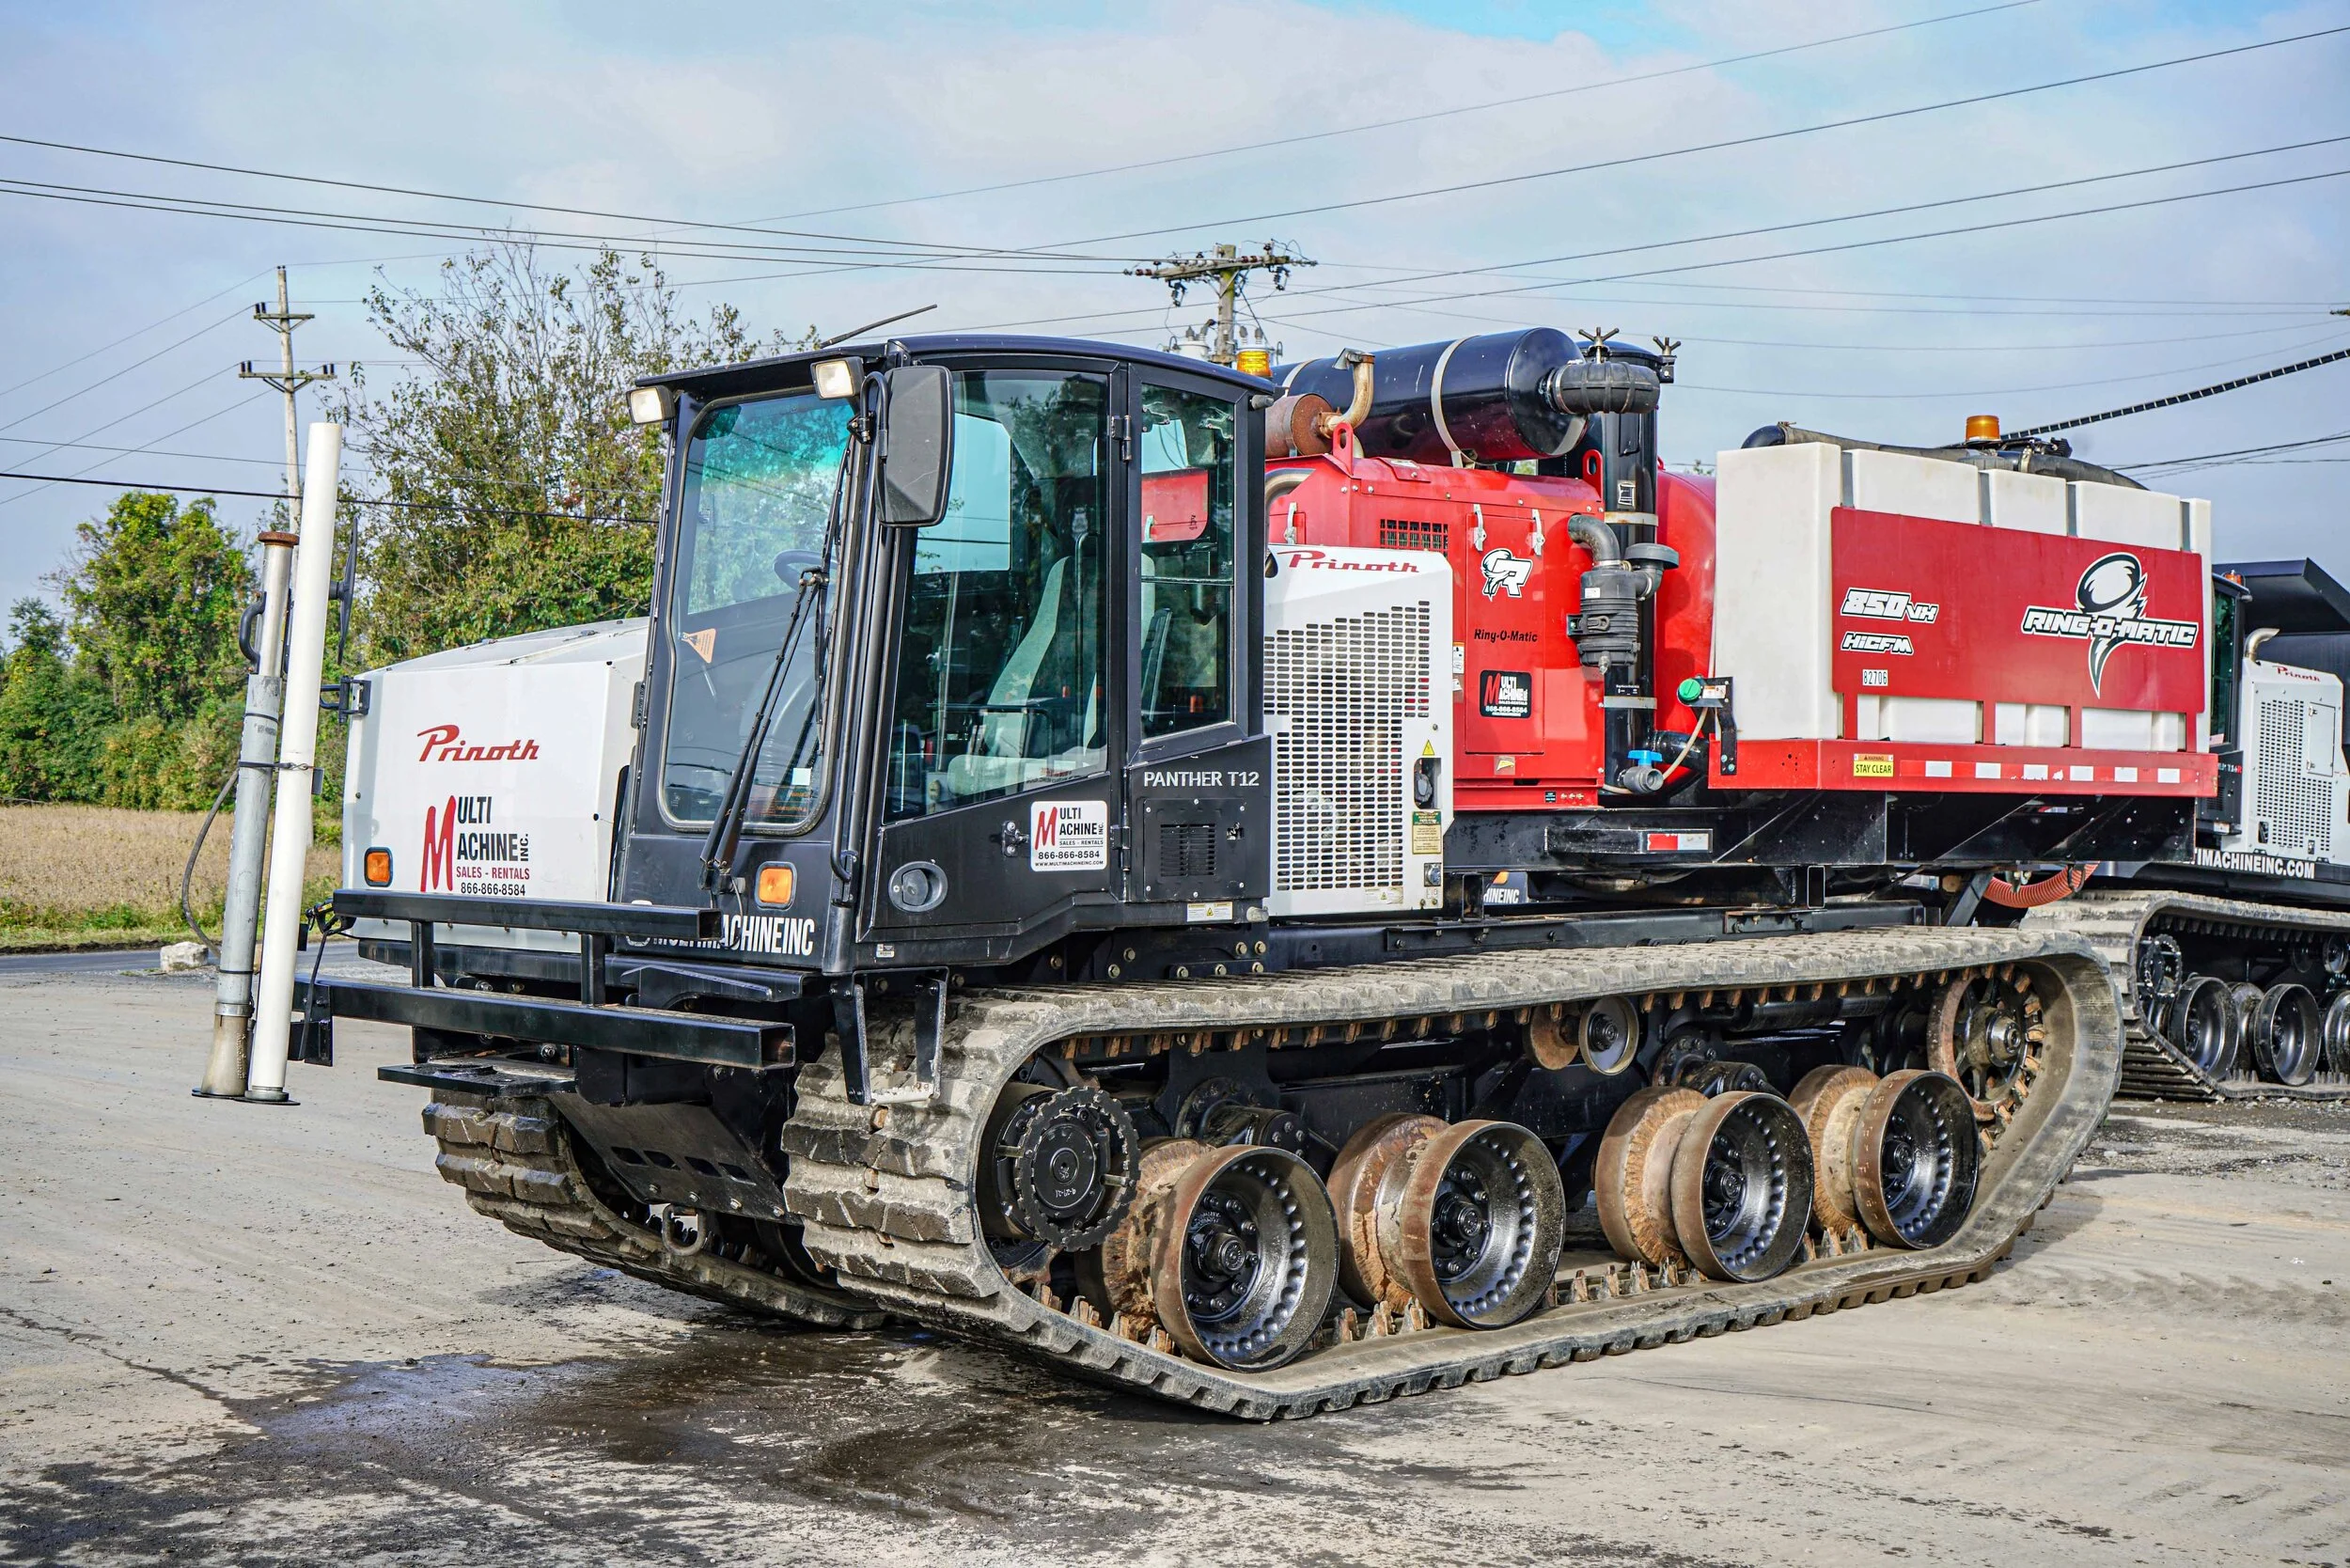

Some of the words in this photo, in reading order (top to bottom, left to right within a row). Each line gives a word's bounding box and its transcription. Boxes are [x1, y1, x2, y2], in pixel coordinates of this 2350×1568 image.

[1277, 550, 1419, 572] Prinoth
[2022, 607, 2200, 646] RING-O-MATIC
[1474, 628, 1538, 643] Ring-O-Matic
[1863, 670, 1888, 685] 82706
[2272, 666, 2321, 682] Prinoth
[416, 724, 540, 761] Prinoth
[1856, 764, 1871, 774] STAY
[1872, 764, 1892, 774] CLEAR
[1143, 771, 1223, 787] PANTHER
[1227, 771, 1260, 787] T12
[1038, 850, 1100, 860] 866-866-8584
[456, 866, 482, 879] SALES
[492, 867, 530, 881] RENTALS
[461, 882, 525, 897] 866-866-8584
